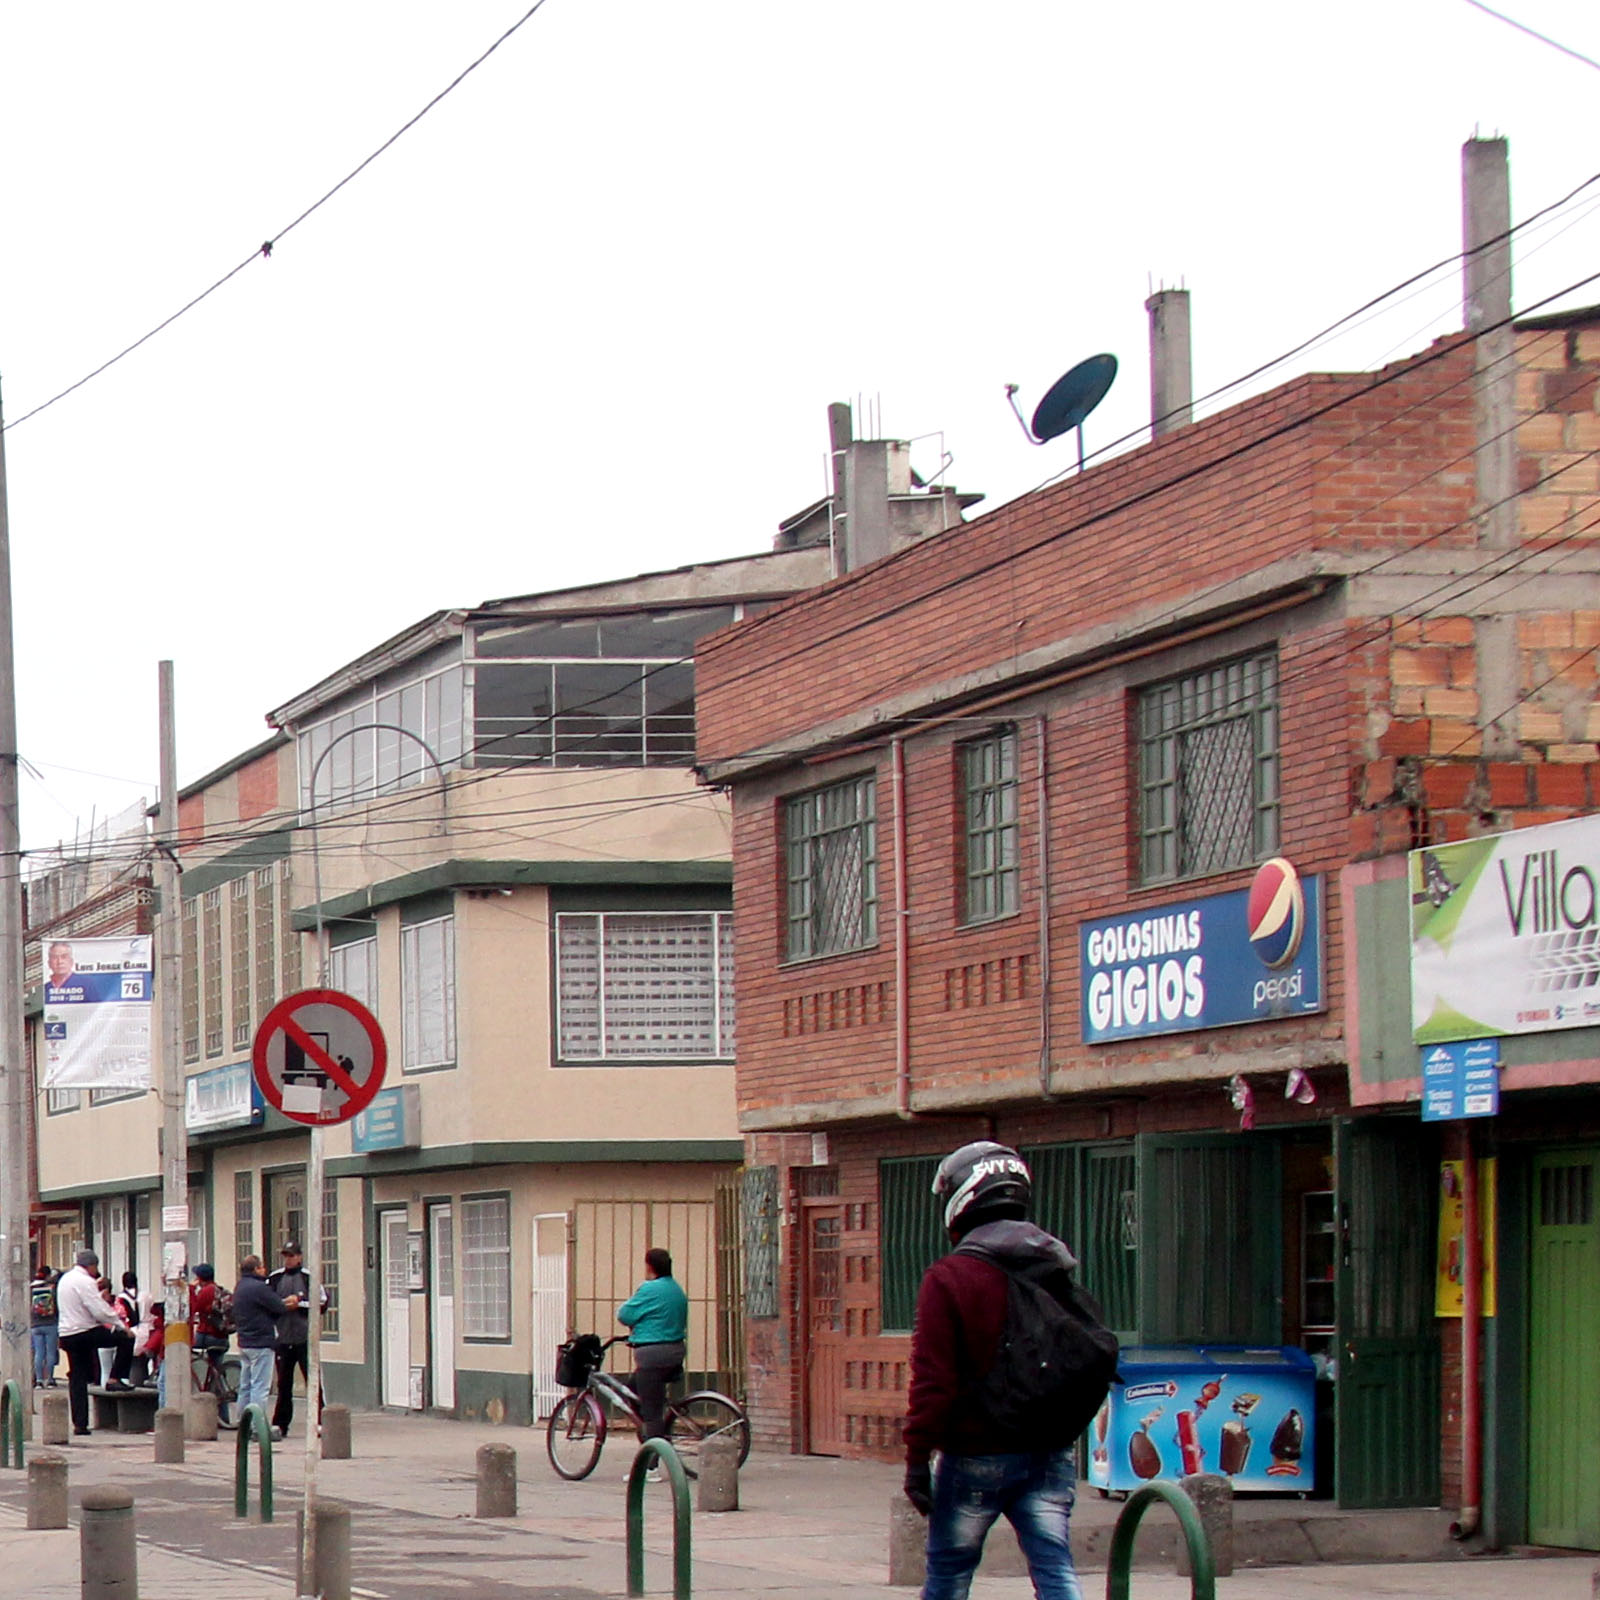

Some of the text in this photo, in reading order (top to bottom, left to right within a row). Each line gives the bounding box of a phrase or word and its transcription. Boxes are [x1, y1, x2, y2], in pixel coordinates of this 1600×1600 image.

[1087, 910, 1200, 966] GOLOSINAS
[49, 987, 83, 995] SENADO
[123, 983, 140, 994] 76
[1088, 955, 1204, 1030] GIGIOS
[1253, 969, 1303, 1009] pepsi
